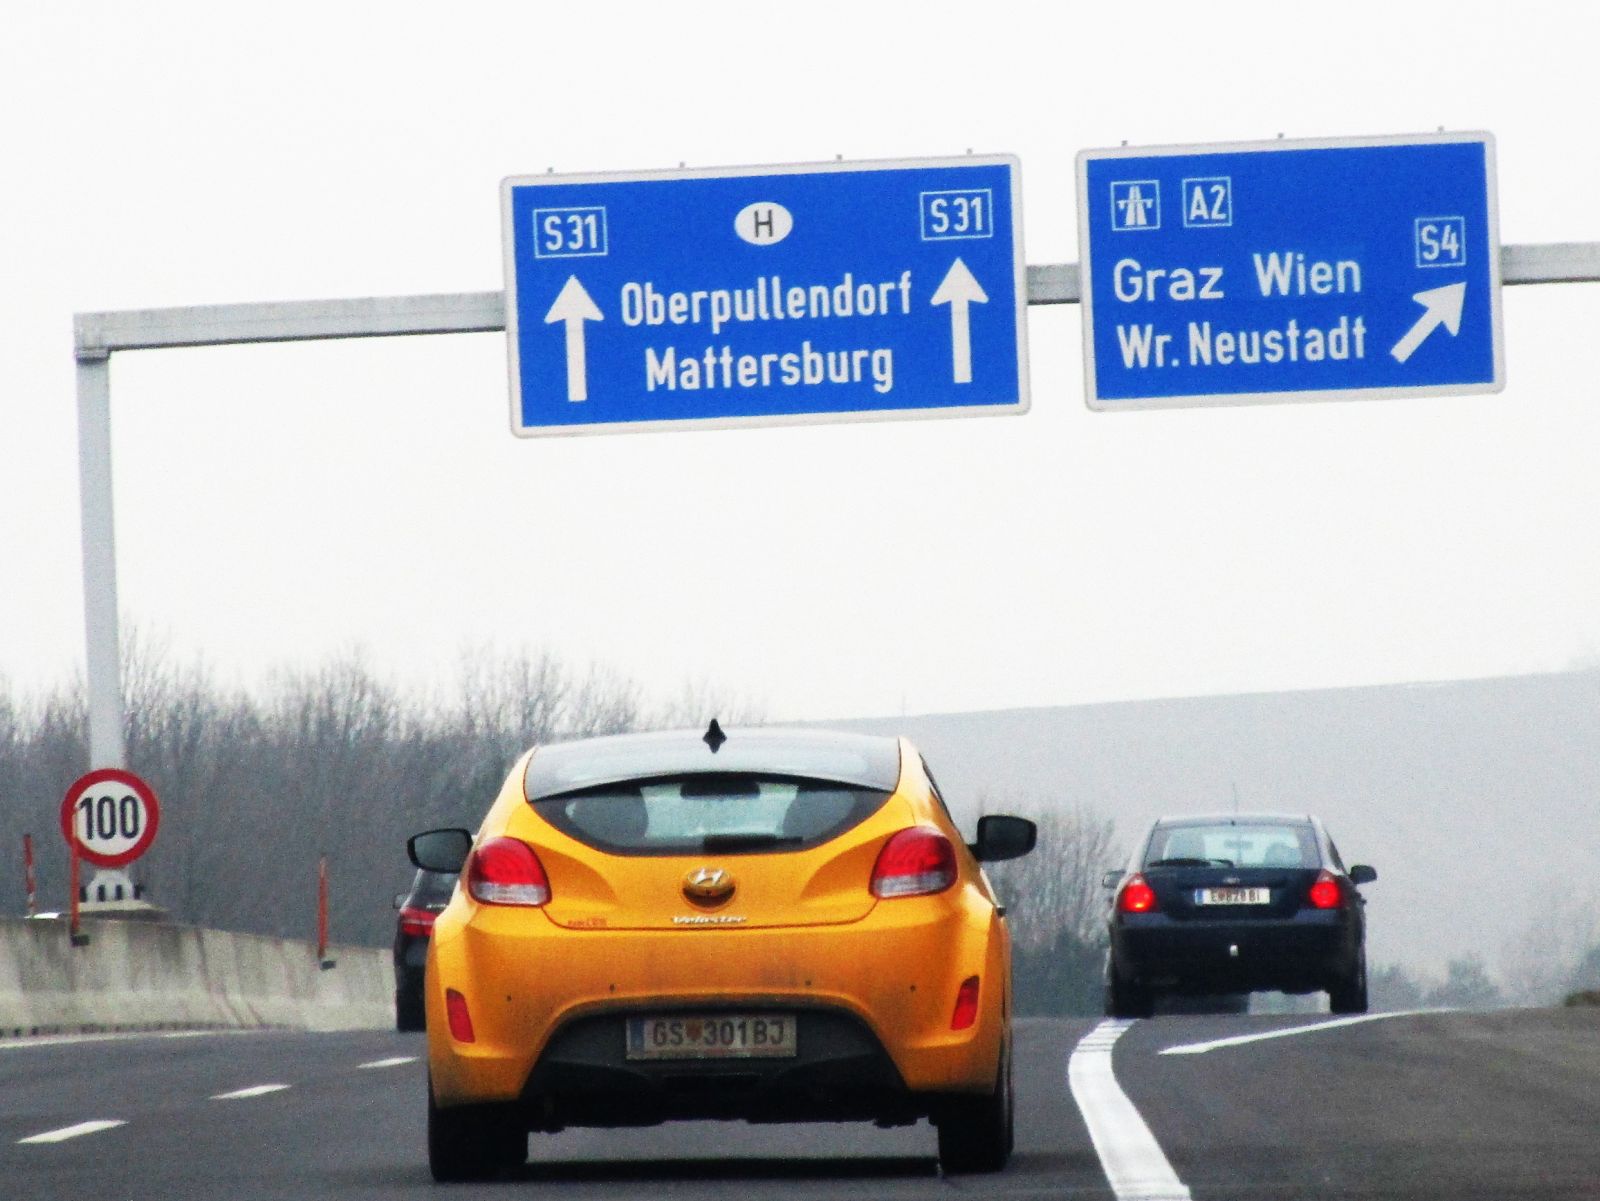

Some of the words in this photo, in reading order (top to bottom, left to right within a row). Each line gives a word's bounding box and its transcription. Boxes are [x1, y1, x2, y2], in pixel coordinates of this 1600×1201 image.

[753, 209, 775, 238] H
[931, 195, 984, 234] S31
[1188, 184, 1228, 221] A2
[544, 212, 599, 252] S31
[1420, 224, 1461, 261] S4
[1113, 258, 1225, 303] Graz
[1252, 250, 1361, 298] Wien
[620, 269, 913, 335] Oberpullendorf
[1117, 322, 1180, 370] Wr.
[1188, 315, 1367, 367] Neustadt
[645, 339, 893, 394] Mattersburg
[78, 794, 140, 841] 100
